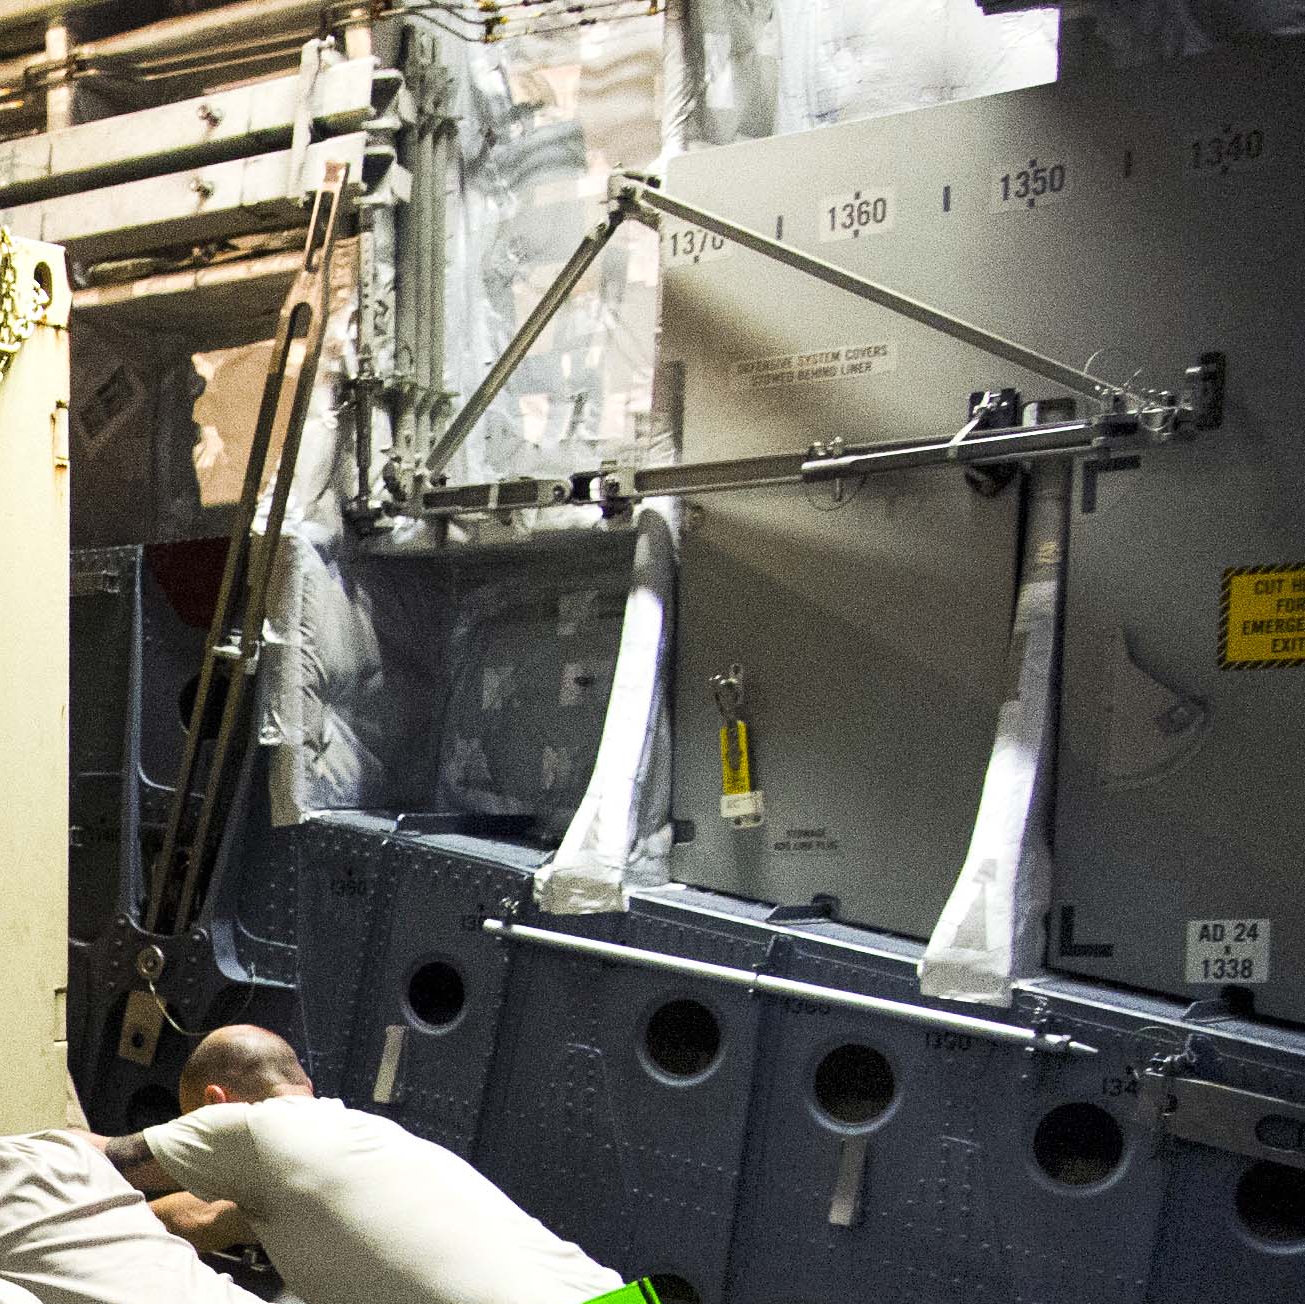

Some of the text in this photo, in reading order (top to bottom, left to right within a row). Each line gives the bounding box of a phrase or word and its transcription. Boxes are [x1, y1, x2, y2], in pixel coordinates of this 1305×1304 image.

[1192, 127, 1264, 170] 1340
[1000, 163, 1066, 202] 1350
[828, 197, 887, 232] 1360
[845, 344, 888, 361] COVERS
[840, 360, 873, 376] LINER
[1253, 578, 1285, 595] CUT
[1271, 637, 1305, 653] EXIT
[1198, 921, 1260, 943] AD 24
[1201, 958, 1254, 980] 1338
